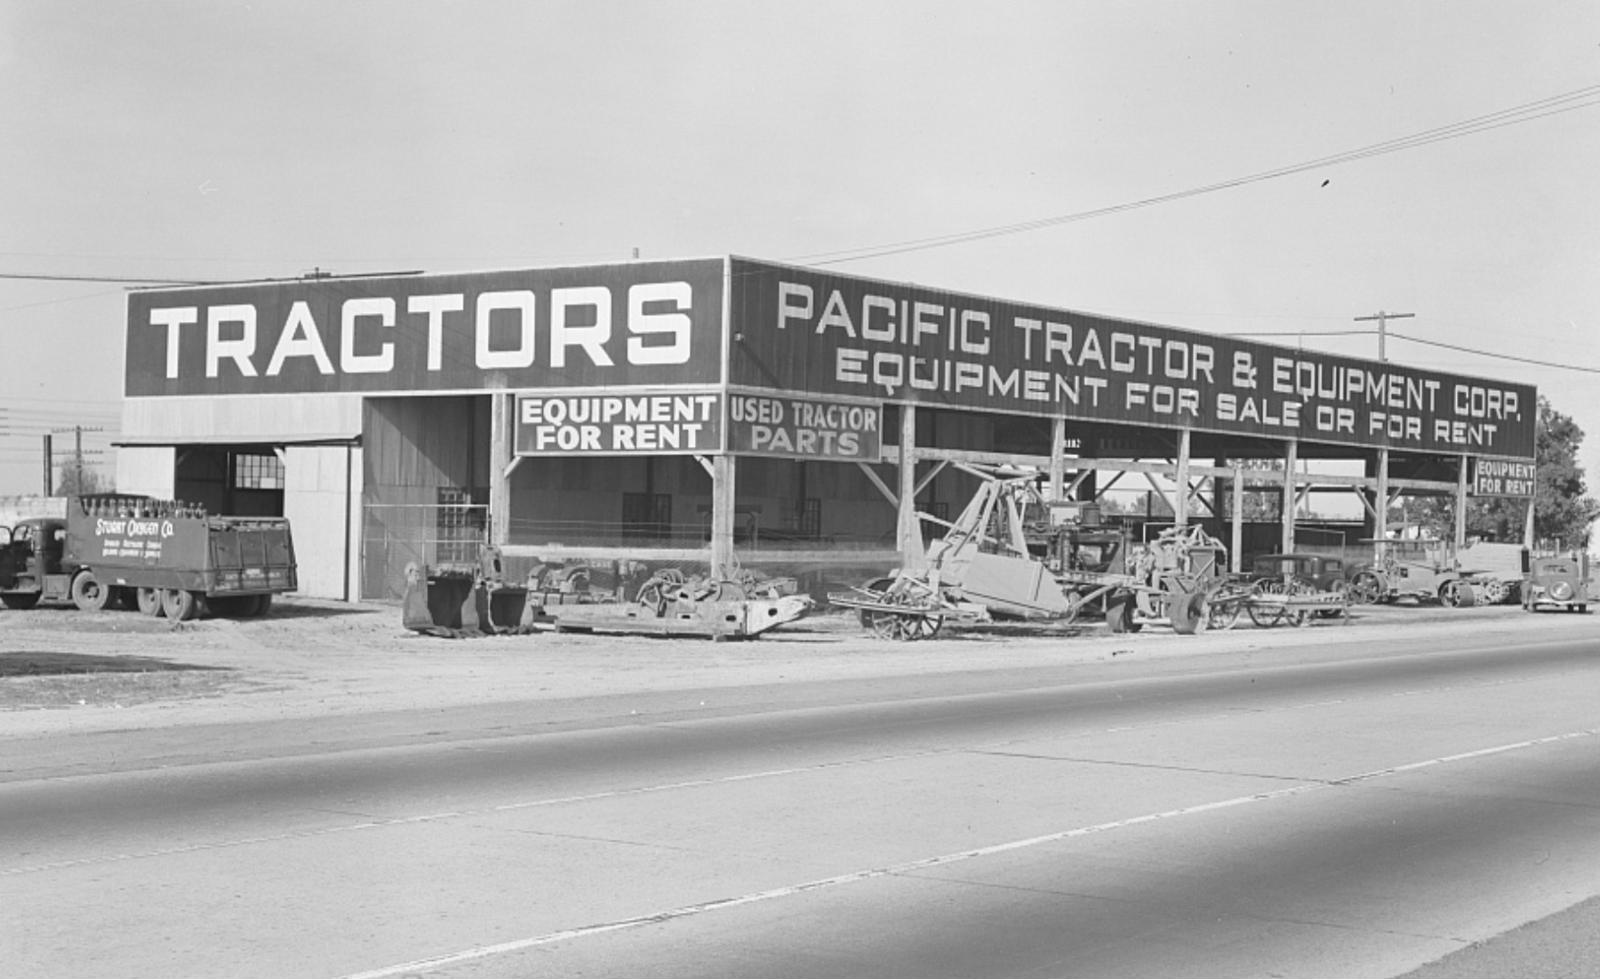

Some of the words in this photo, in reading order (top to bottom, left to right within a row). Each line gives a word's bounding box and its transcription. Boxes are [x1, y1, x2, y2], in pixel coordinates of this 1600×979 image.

[149, 281, 692, 378] TRACTORS
[777, 281, 990, 355] PACIFIC
[1014, 317, 1214, 383] TRACTOR
[1232, 351, 1257, 389] &
[1273, 356, 1440, 412] EQUIPMENT
[1454, 385, 1521, 422] CORP.
[521, 396, 717, 425] EQUIPMENT
[836, 347, 1108, 407] EQUIPMENT
[1126, 382, 1200, 417] FOR
[1216, 394, 1301, 428] SALE
[1316, 405, 1355, 433] OR
[1369, 412, 1422, 441] FOR
[1434, 420, 1498, 447] RENT
[731, 396, 784, 425] USED
[791, 403, 877, 432] TRACTOR
[536, 425, 603, 450] FOR
[612, 424, 703, 449] RENT
[751, 425, 859, 455] PARTS
[1478, 461, 1535, 479] EQUIPMENT
[1480, 478, 1501, 493] FOR
[1505, 480, 1533, 495] RENT
